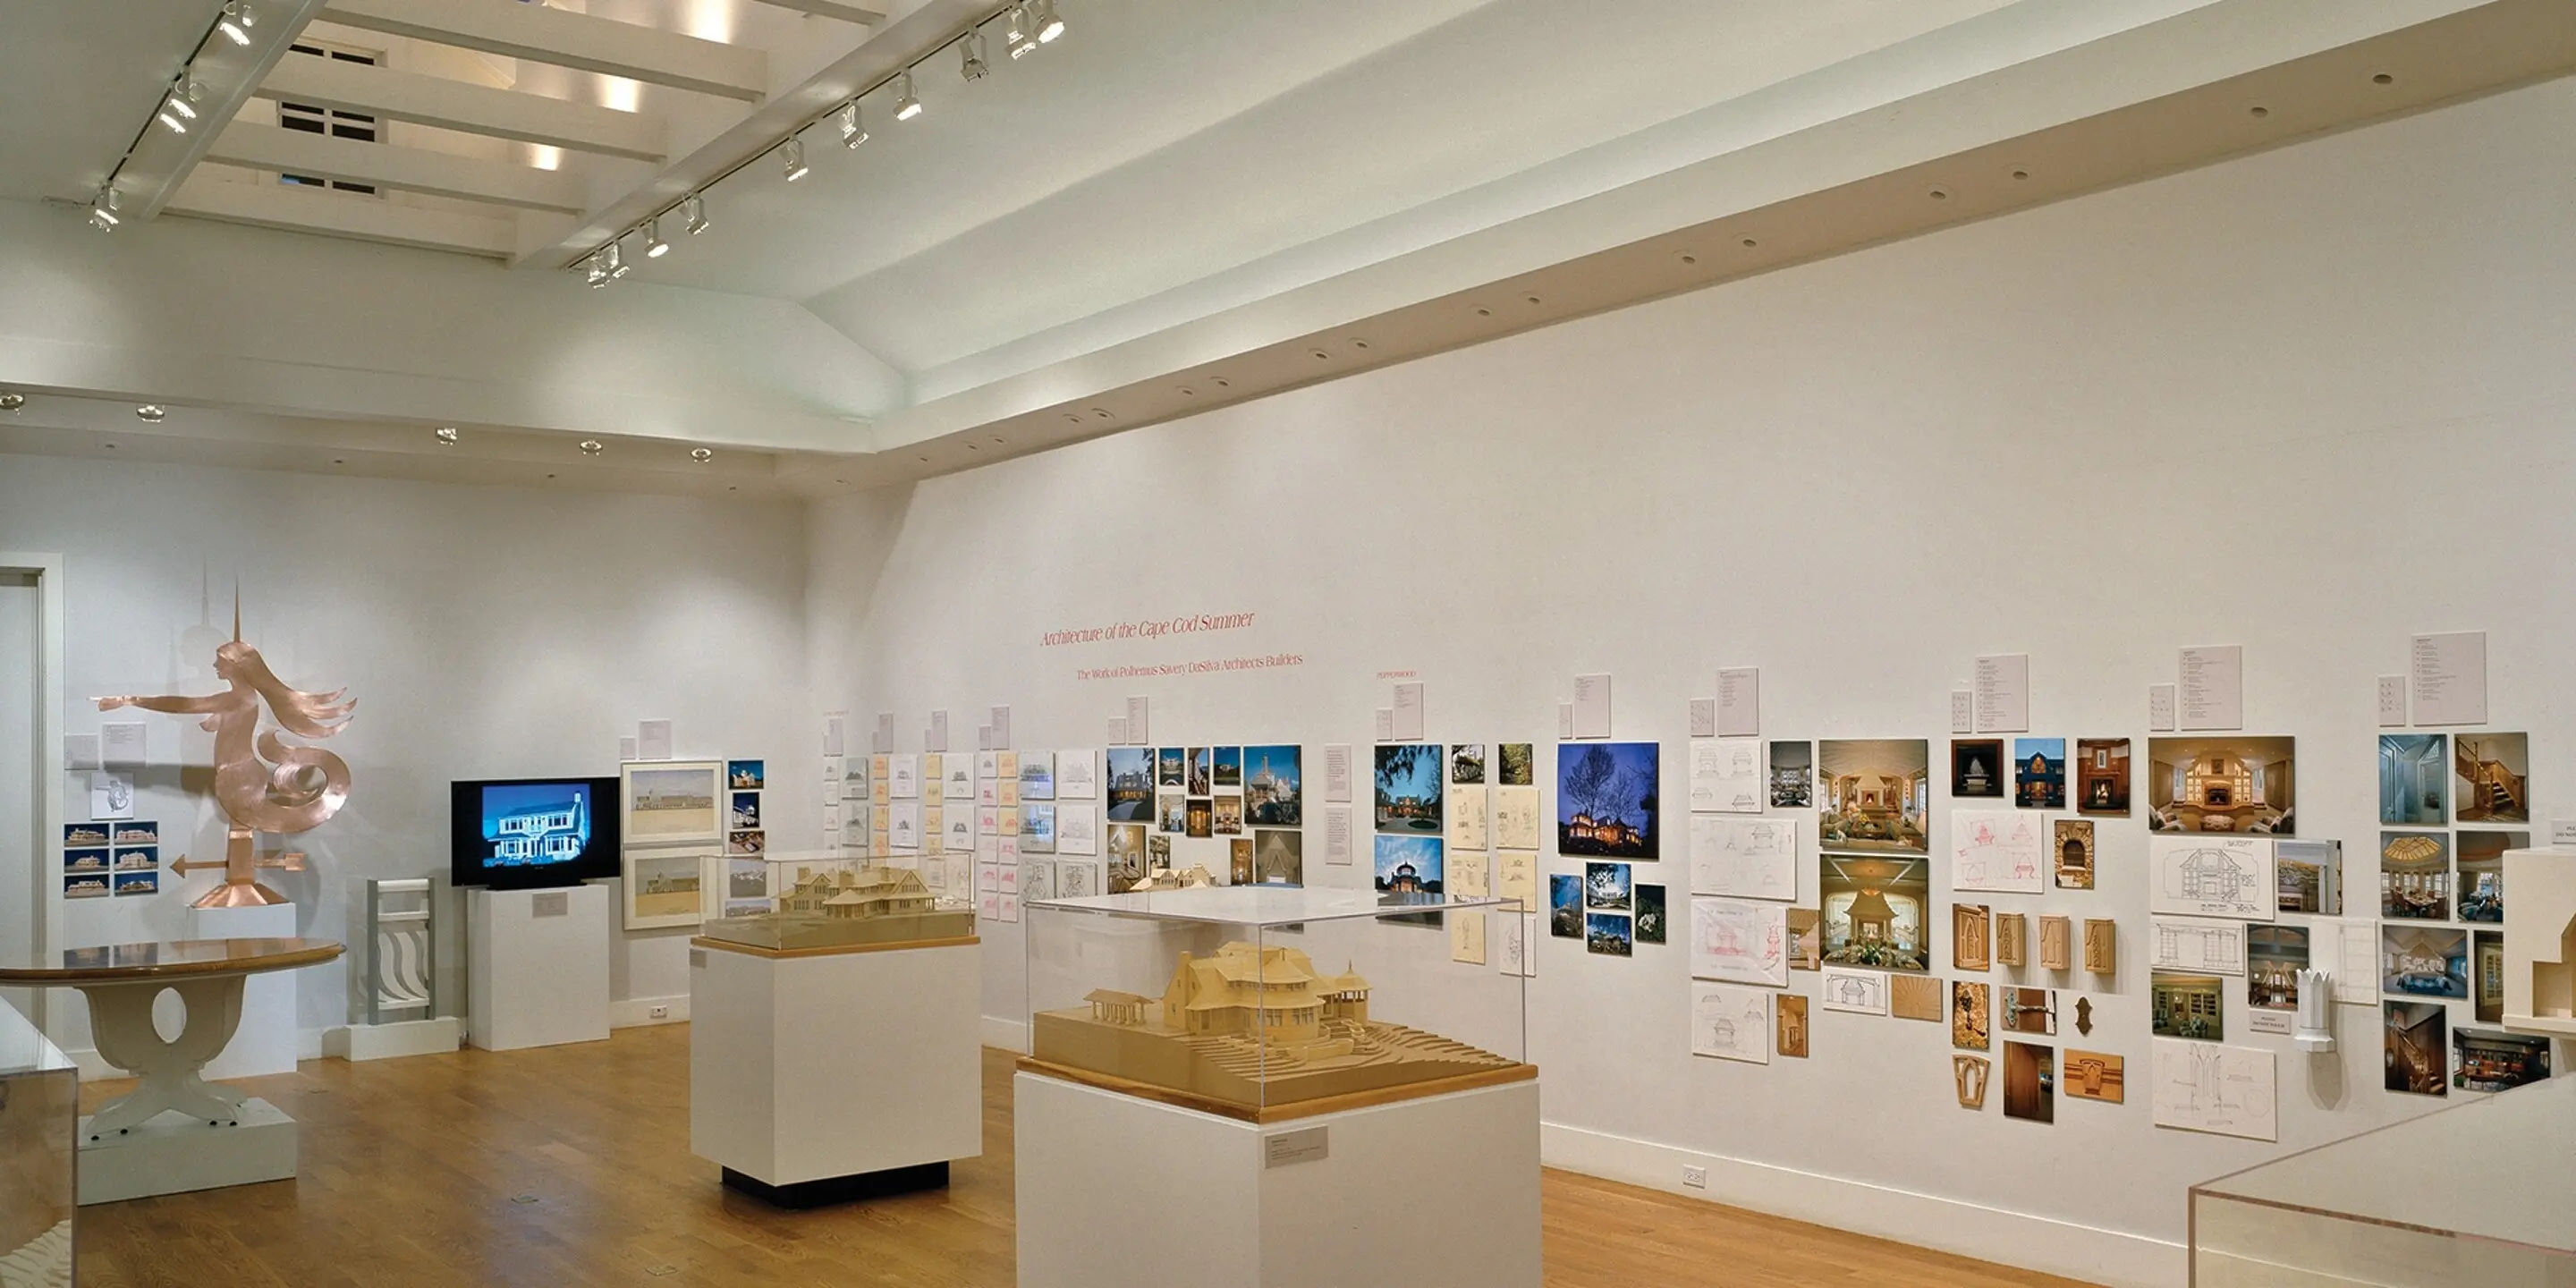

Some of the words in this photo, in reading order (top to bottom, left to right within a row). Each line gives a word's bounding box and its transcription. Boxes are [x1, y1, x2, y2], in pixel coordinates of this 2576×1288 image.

[1040, 629, 1103, 647] Architecture
[1105, 623, 1118, 640] of
[1119, 622, 1137, 639] the
[1139, 621, 1170, 640] Cape
[1172, 614, 1199, 634] Cod
[1199, 612, 1255, 631] Summer
[1266, 653, 1303, 667] Builders
